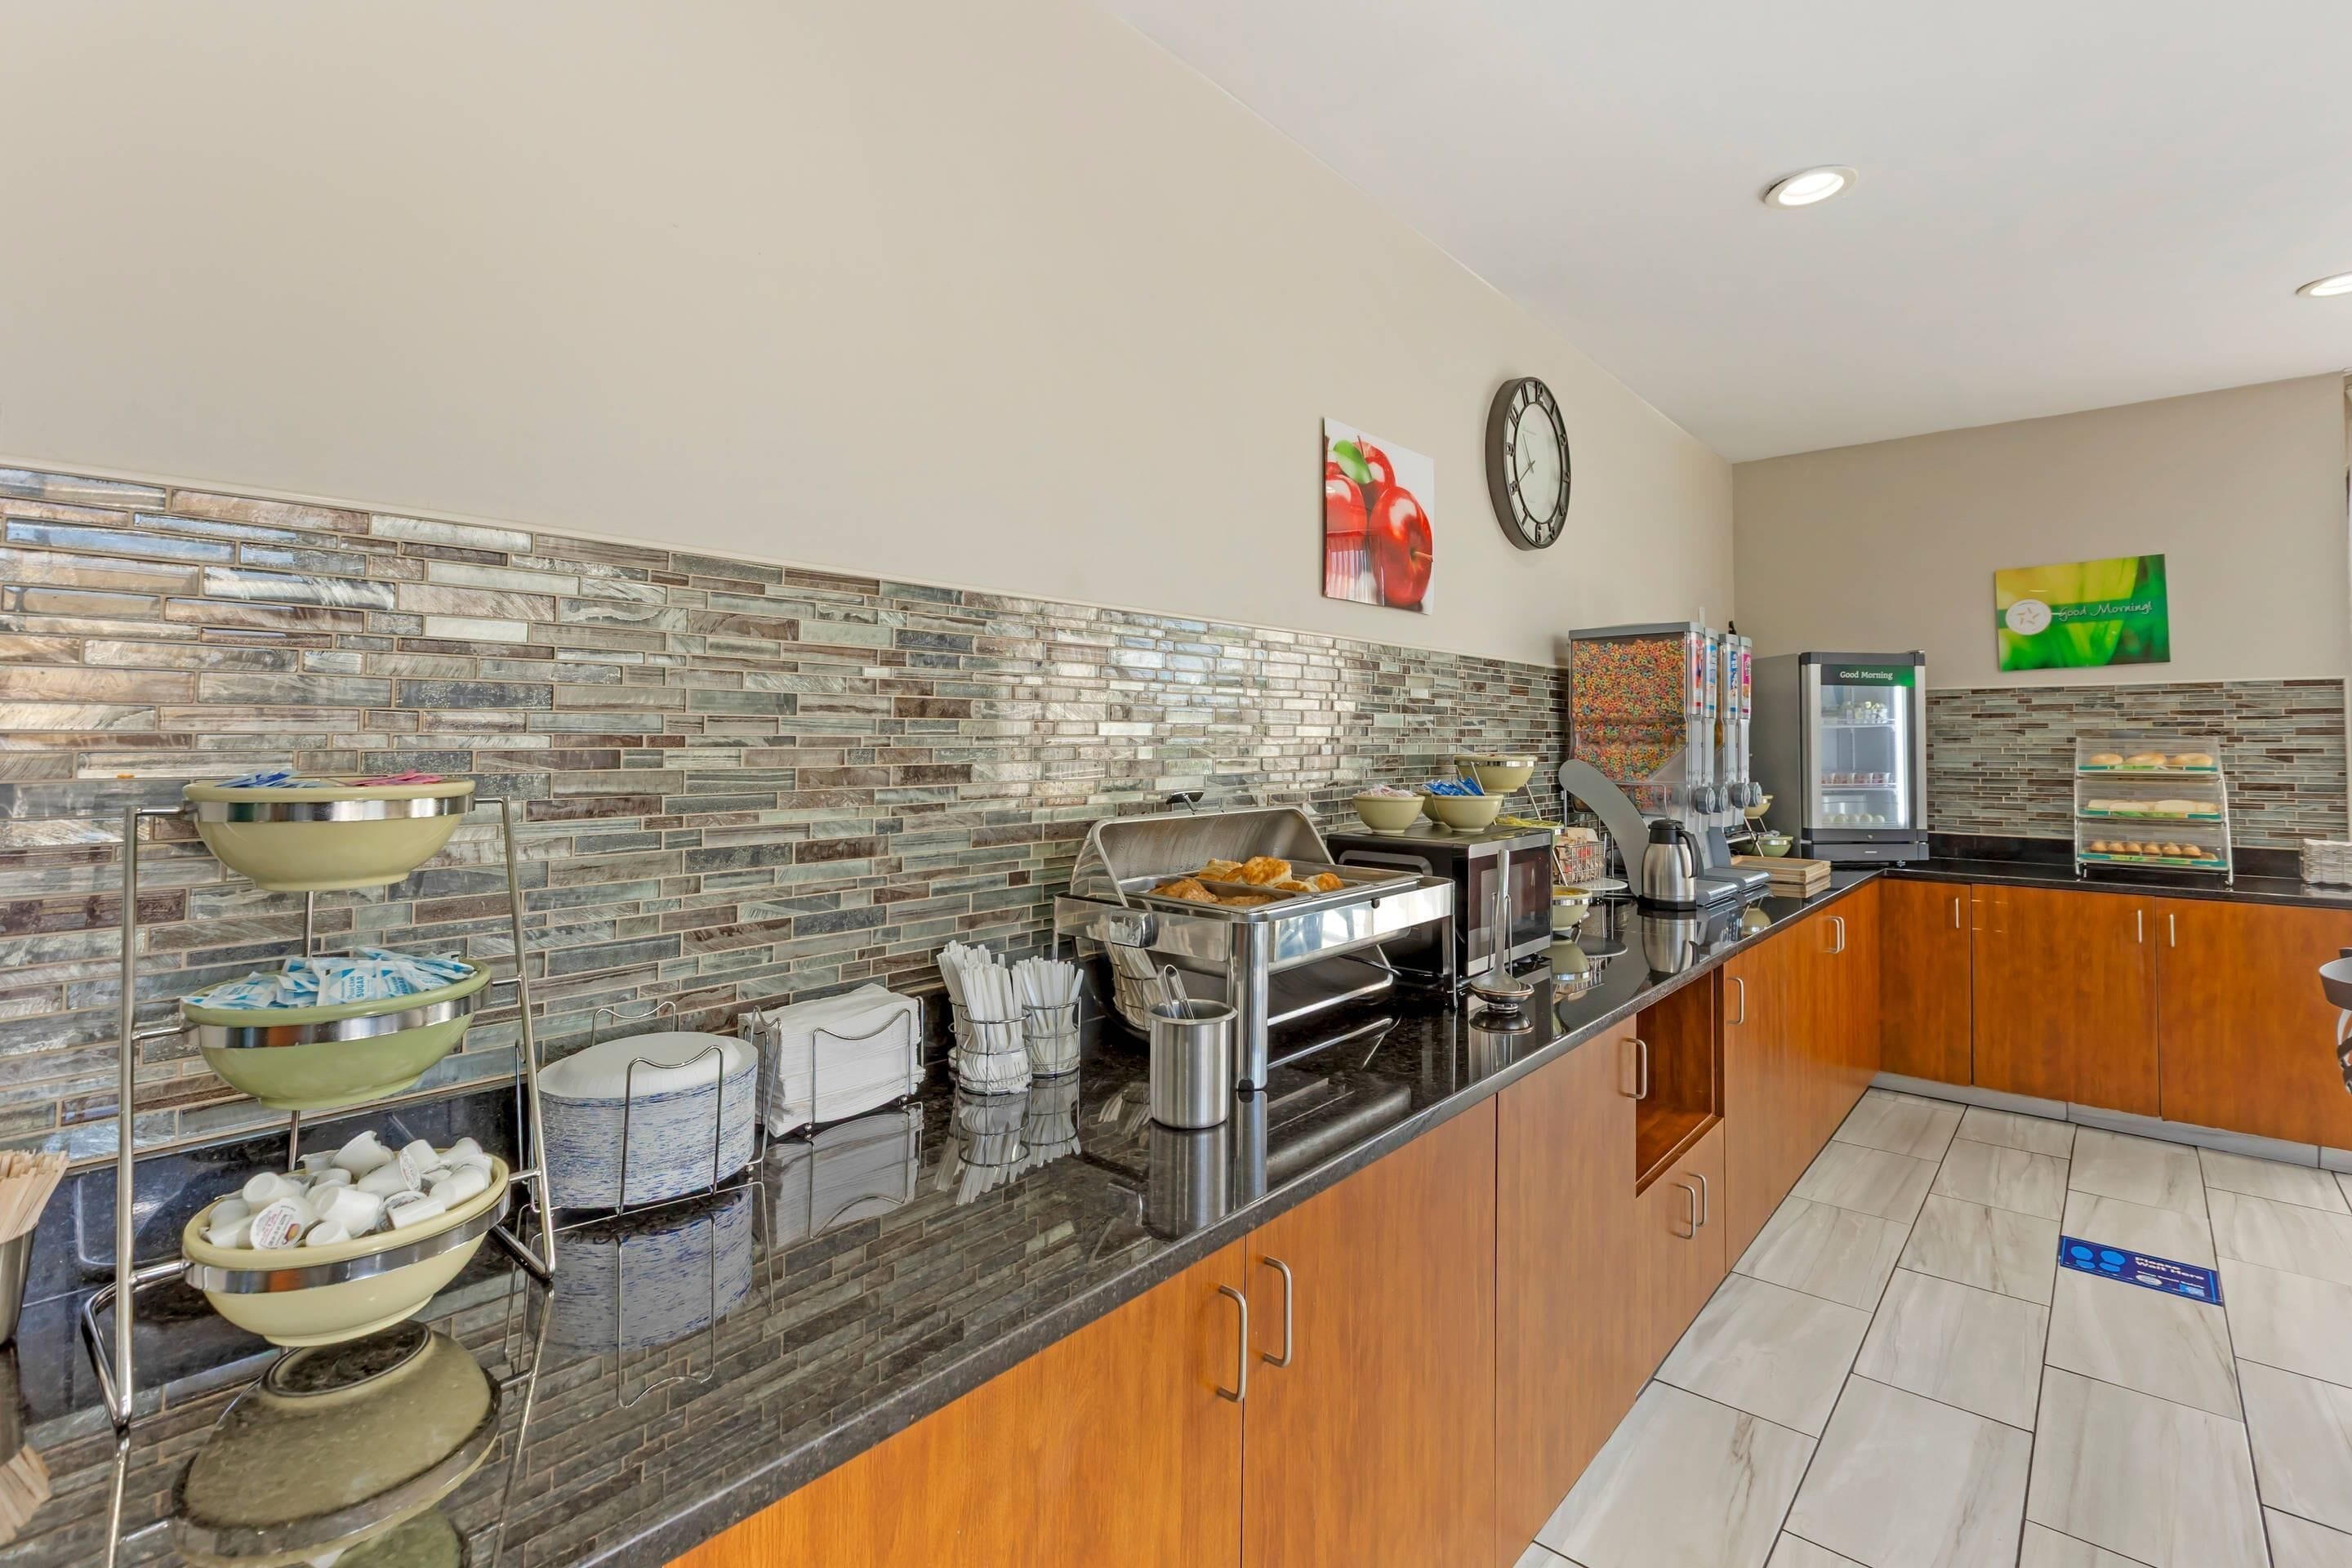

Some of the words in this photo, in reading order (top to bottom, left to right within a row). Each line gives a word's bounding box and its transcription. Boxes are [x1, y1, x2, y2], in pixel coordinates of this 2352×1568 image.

[1535, 381, 1544, 405] 12
[1510, 480, 1519, 496] 8
[1535, 523, 1542, 544] 6
[2058, 606, 2087, 621] Good
[2091, 601, 2152, 617] Morning!
[1840, 670, 1860, 679] Good
[1861, 671, 1893, 680] Morning
[356, 975, 365, 998] SUGAR
[2135, 1257, 2180, 1270] Please
[2135, 1260, 2167, 1272] Wait
[2170, 1269, 2204, 1280] Here
